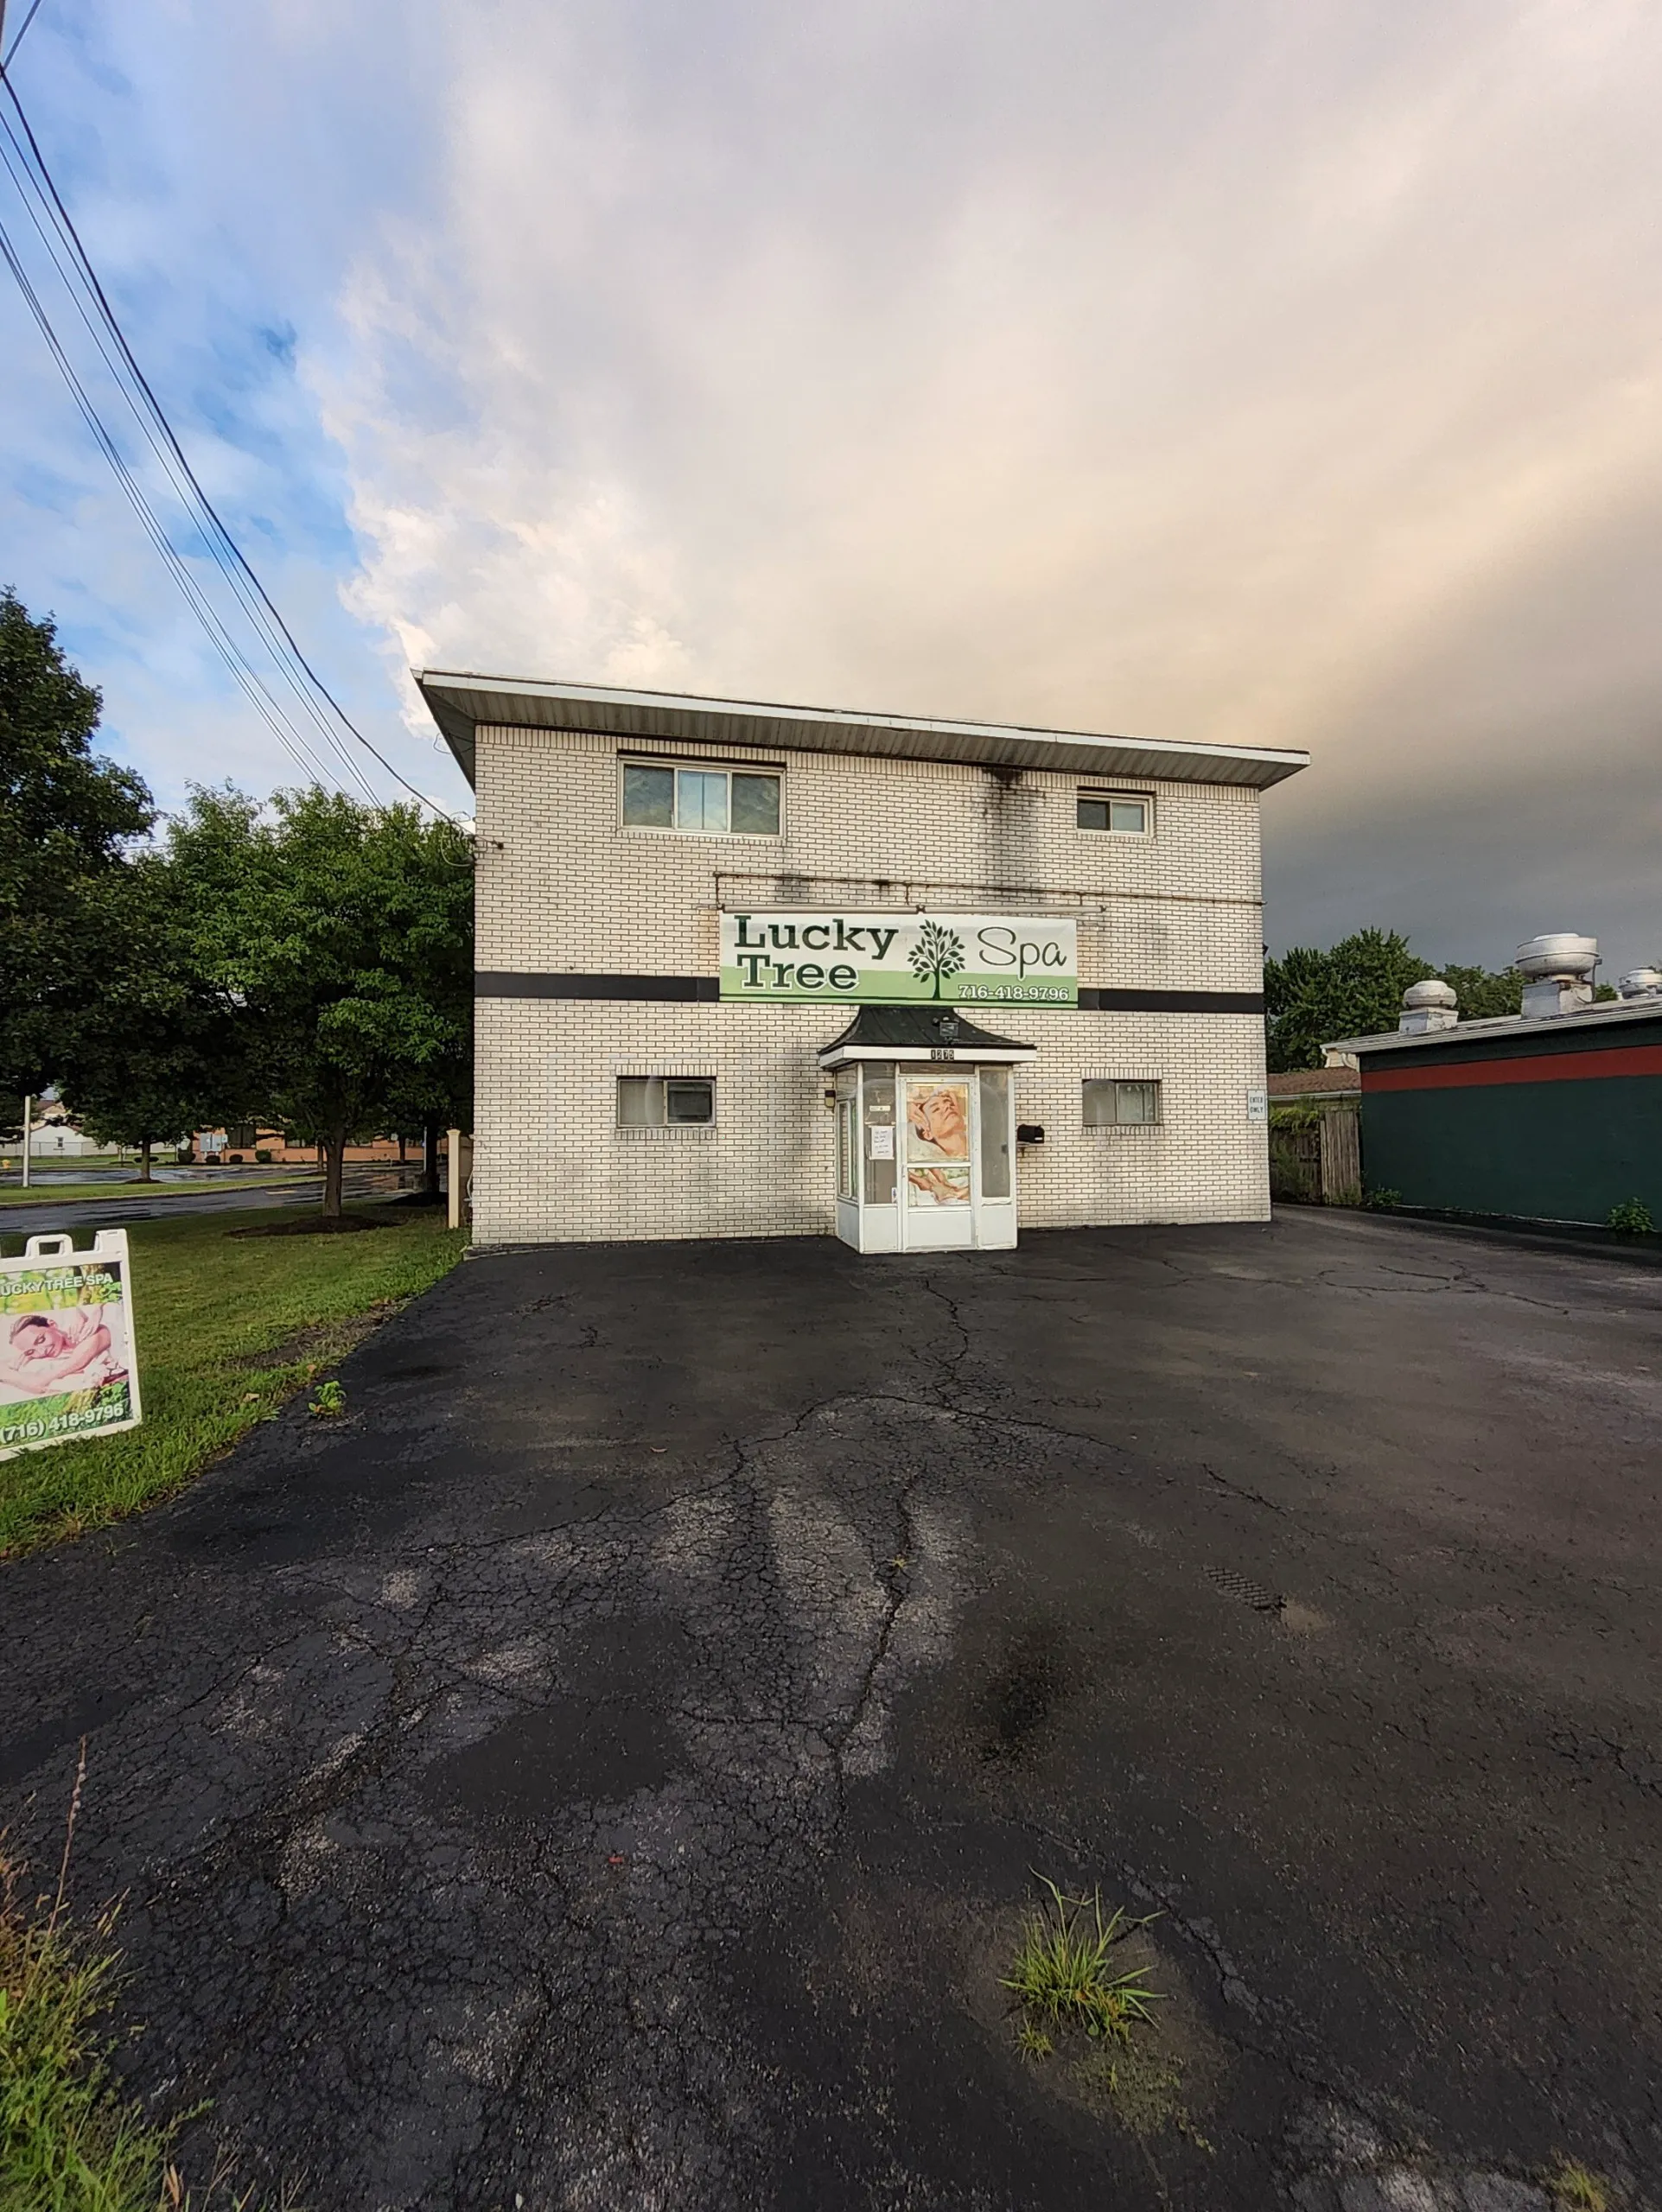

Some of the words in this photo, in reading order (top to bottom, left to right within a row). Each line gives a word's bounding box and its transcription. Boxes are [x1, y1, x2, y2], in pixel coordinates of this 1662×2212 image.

[734, 914, 899, 961] Lucky
[977, 925, 1068, 980] Spa
[736, 952, 860, 991] Tree
[958, 983, 1070, 1001] 716-418-9796
[931, 1049, 955, 1061] 1275
[0, 1281, 44, 1296] UCKY
[44, 1275, 84, 1291] TREE
[86, 1272, 114, 1286] SPA
[0, 1418, 46, 1445] (716)
[48, 1402, 124, 1432] 418-9796
